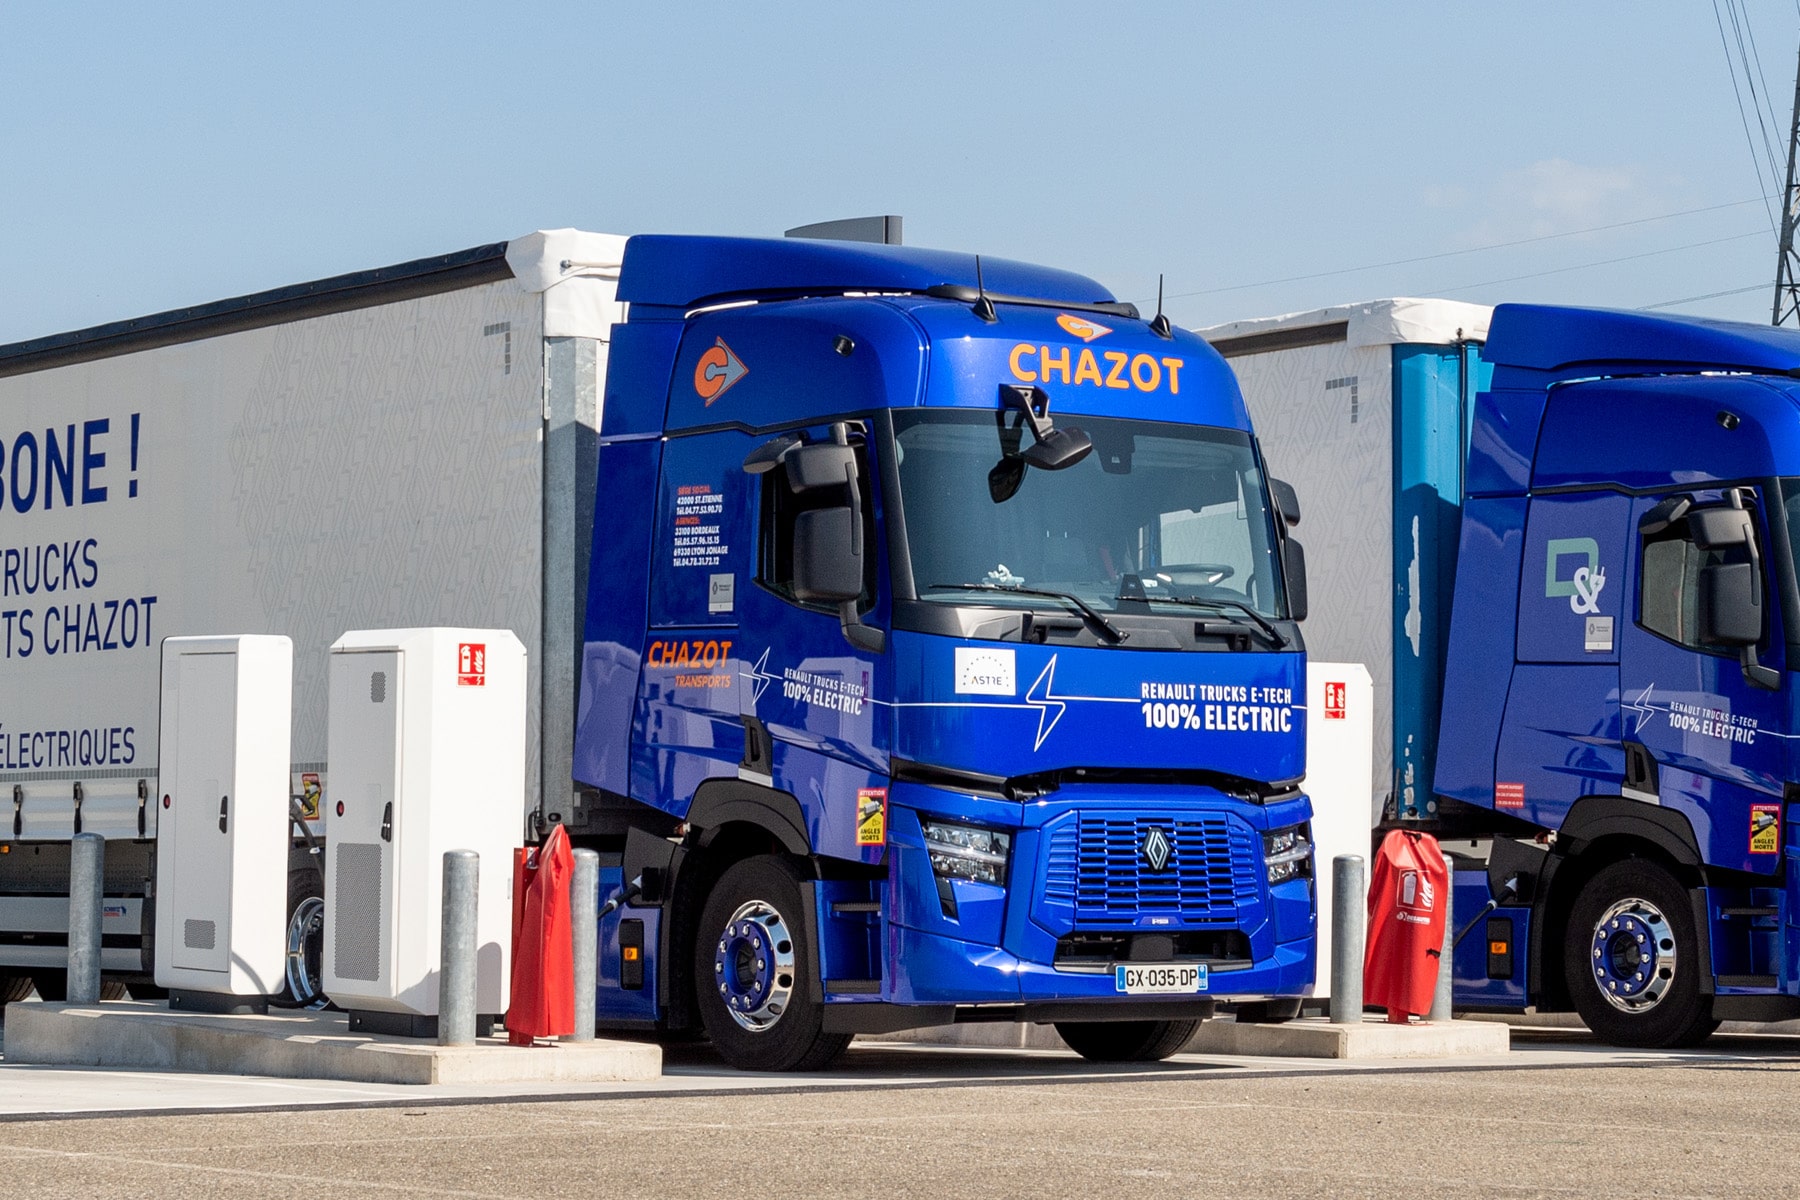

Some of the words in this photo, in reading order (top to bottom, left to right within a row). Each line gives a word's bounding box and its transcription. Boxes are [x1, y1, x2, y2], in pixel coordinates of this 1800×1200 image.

[1009, 343, 1184, 395] CHAZOT
[0, 417, 110, 514] ONE
[691, 525, 720, 535] BORDEAUX
[691, 546, 706, 556] LYON
[706, 545, 728, 555] JONAGE
[0, 538, 98, 596] RUCKS
[43, 596, 158, 656] CHAZOT
[648, 641, 732, 669] CHAZOT
[675, 675, 731, 688] TRANSPORTS
[784, 667, 812, 683] RENAULT
[813, 675, 838, 691] TRUCKS
[840, 680, 865, 697] E-TECH
[971, 675, 1002, 686] ASTRE
[1141, 682, 1196, 700] RENAULT
[1200, 685, 1247, 702] TRUCKS
[1251, 687, 1292, 704] E-TECH
[783, 681, 811, 703] 100%
[813, 688, 863, 716] ELECTRIC
[1141, 702, 1200, 730] 100%
[1205, 705, 1292, 733] ELECTRIC
[1669, 701, 1700, 716] RENAULT
[1702, 708, 1729, 722] TRUCKS
[1731, 714, 1758, 729] E-TECH
[1669, 712, 1700, 733] 100%
[1702, 720, 1756, 745] ELECTRIC
